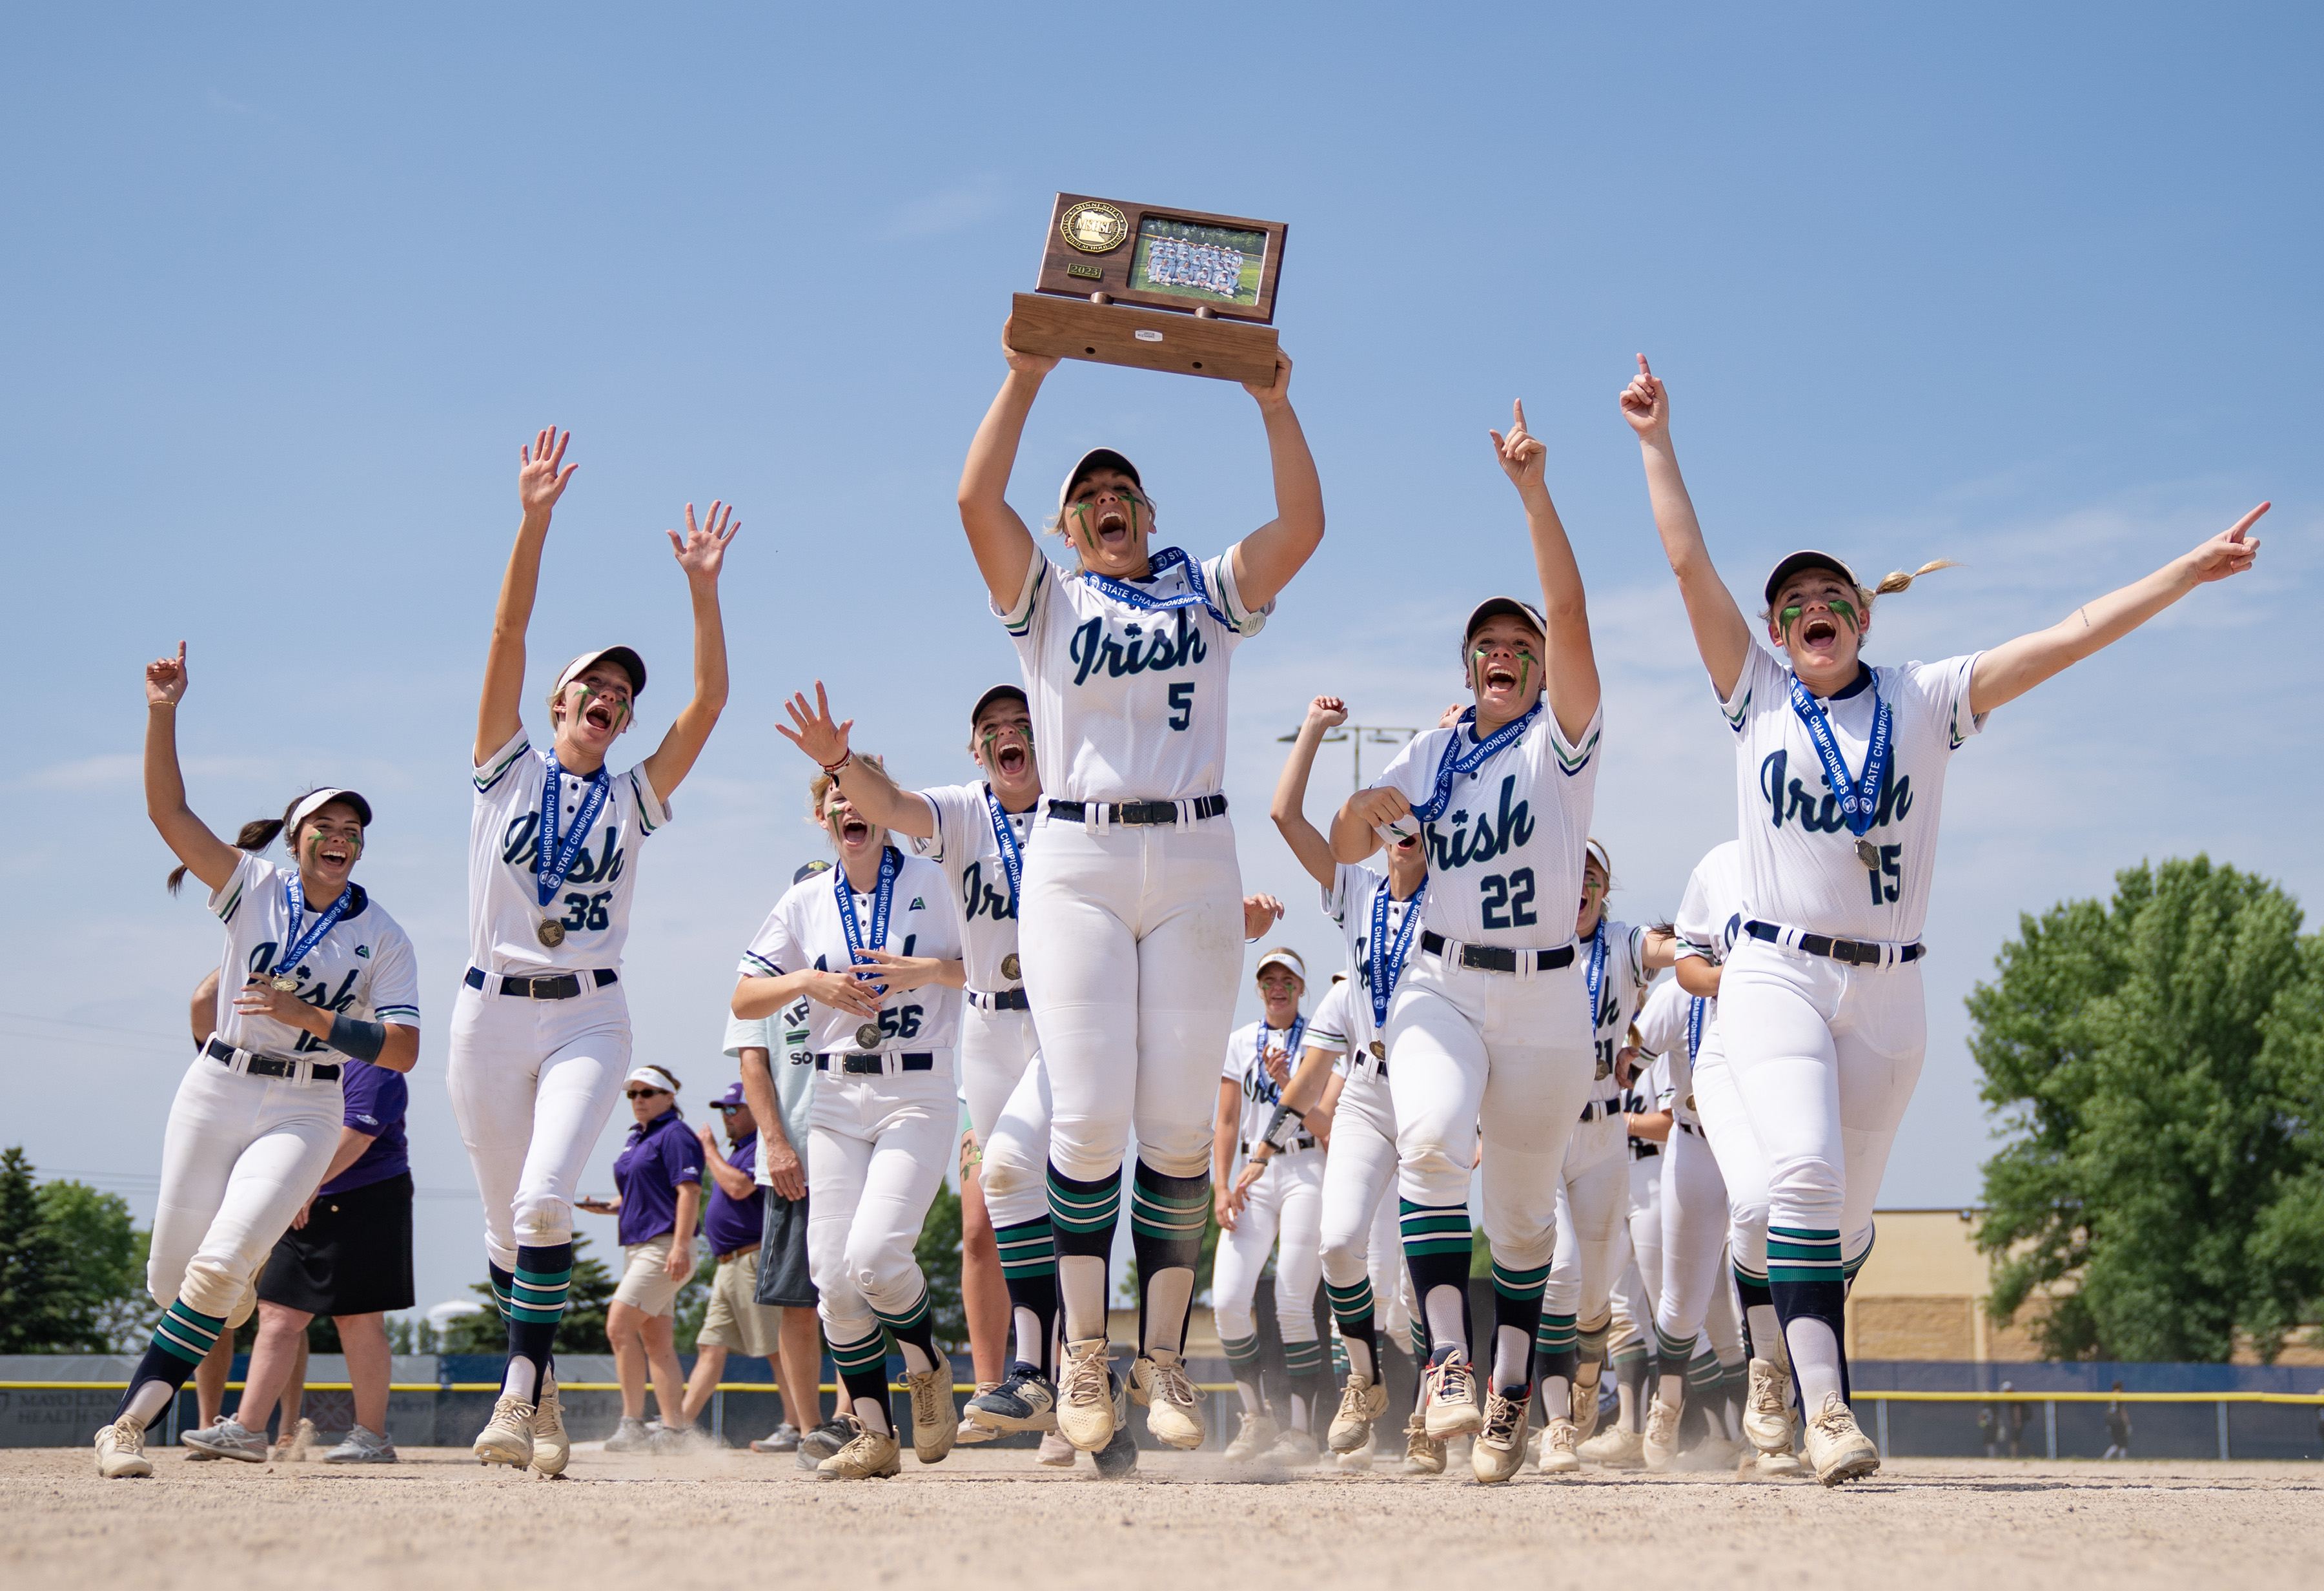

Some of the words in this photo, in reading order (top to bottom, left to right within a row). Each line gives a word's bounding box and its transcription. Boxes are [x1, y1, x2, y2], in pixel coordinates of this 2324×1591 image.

[1075, 203, 1120, 217] MINNESOTA
[1076, 218, 1112, 234] MSHSL
[1067, 235, 1081, 247] HIGH
[1110, 227, 1125, 246] LEAGUE
[1071, 265, 1098, 276] 2023
[1101, 582, 1130, 599] STATE
[1132, 593, 1203, 608] CHAMPIONSHIPS
[1188, 553, 1203, 590] CHAMPIO
[1070, 608, 1207, 686] Irish
[1168, 682, 1196, 732] 5
[1456, 722, 1525, 771] CHAMPIONSHIPS
[1793, 688, 1813, 715] STATE
[1810, 715, 1849, 795] CHAMPIONSHIPS
[1431, 788, 1447, 814] STATE
[1760, 744, 1913, 834] Irih
[1864, 761, 1880, 795] STATE
[543, 794, 555, 867] CHAMPIONSHIPS
[556, 846, 575, 873] STATE
[570, 784, 605, 845] CHAMPIONSHIPS
[991, 806, 1005, 831] STATE
[1422, 774, 1535, 871] rish
[289, 886, 300, 902] STATE
[1869, 842, 1902, 905] 15
[560, 890, 613, 931] 36
[837, 887, 850, 913] STATE
[875, 878, 890, 944] CHAMPIONSHIPS
[1376, 898, 1384, 923] STATE
[1480, 867, 1537, 930] 22
[291, 945, 308, 960] STATE
[304, 907, 341, 944] CHAMPIONSHIPS
[1391, 904, 1420, 968] CHAMPIONSHIPS
[1373, 926, 1383, 994] CHAMPIONSHIPS
[1589, 938, 1604, 991] CHAMPIONSHIPS
[878, 1005, 924, 1040] 56
[1691, 996, 1702, 1055] CHAMPIONSHIPS
[76, 1393, 122, 1407] CLIN
